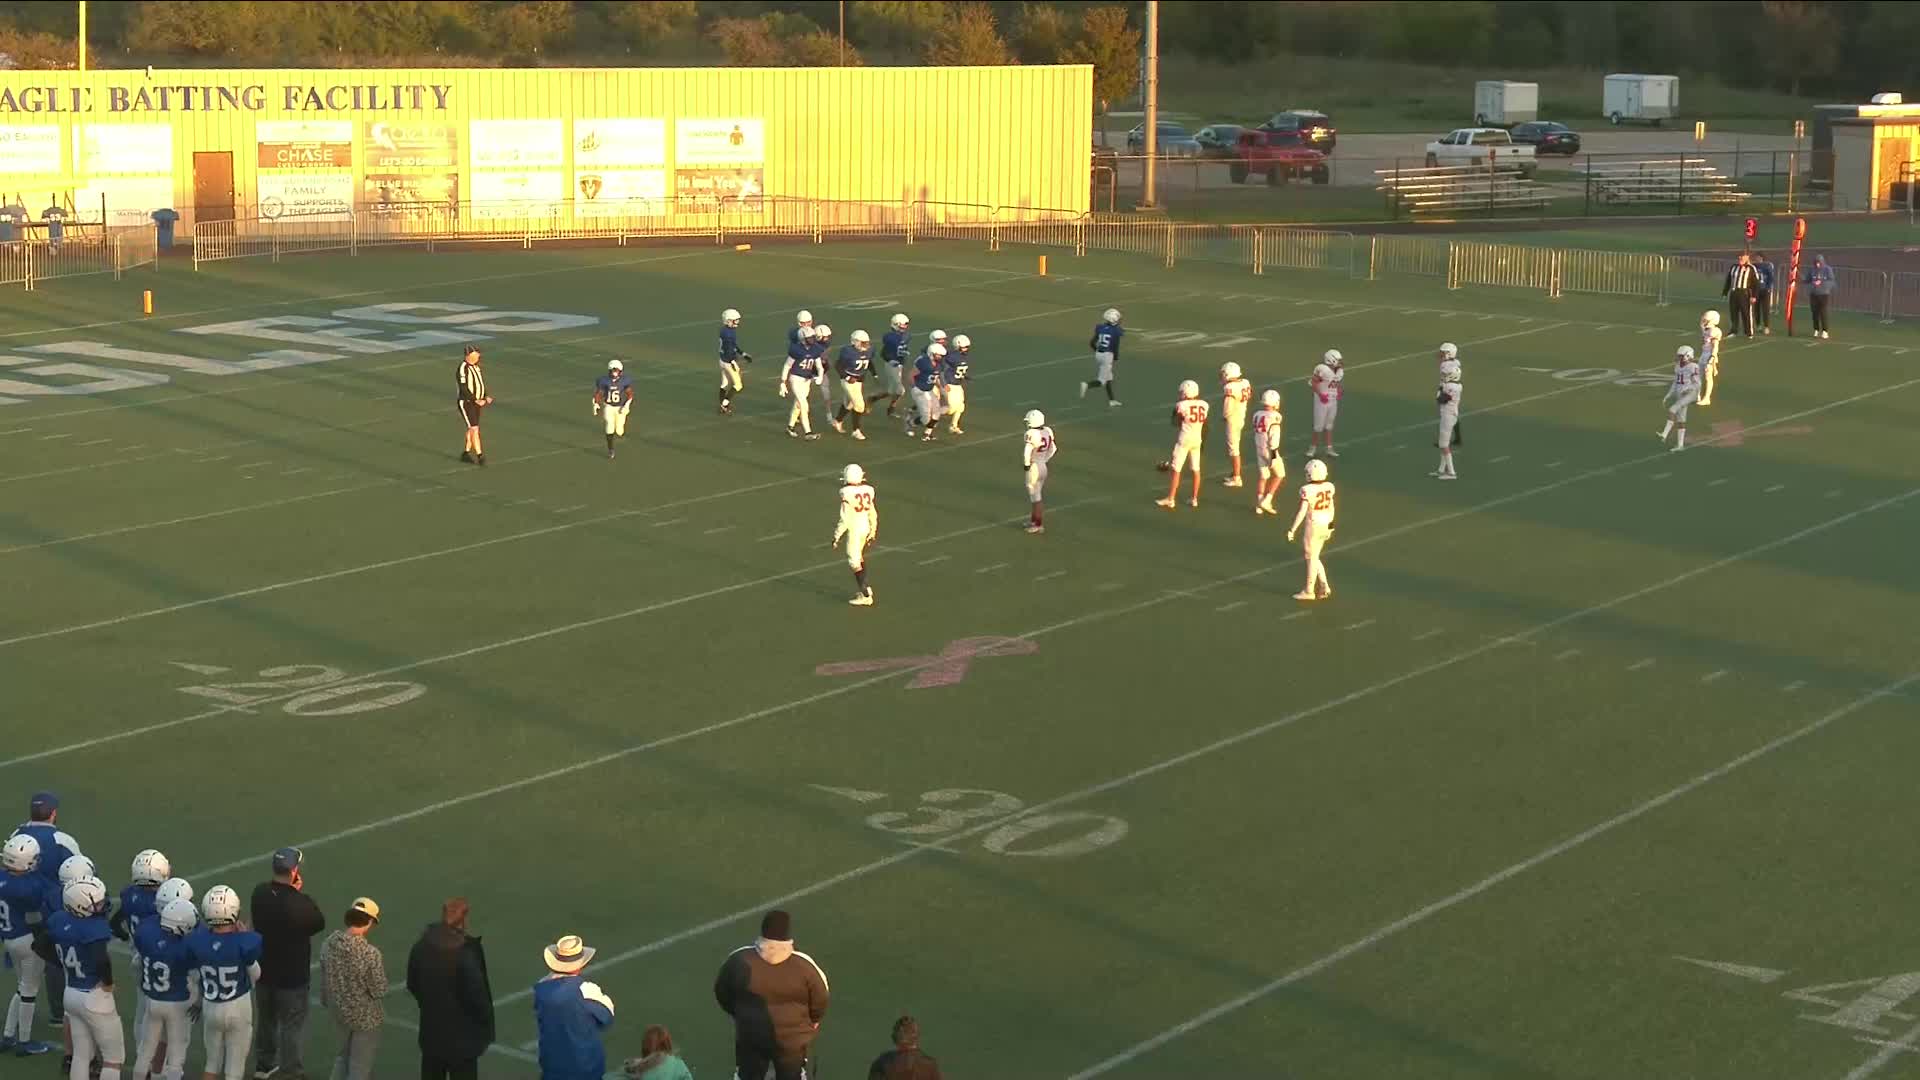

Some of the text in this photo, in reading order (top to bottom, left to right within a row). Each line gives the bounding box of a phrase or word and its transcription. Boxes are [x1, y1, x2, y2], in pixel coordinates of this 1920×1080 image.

[108, 85, 266, 111] BATTING
[282, 85, 452, 110] FACILITY
[277, 149, 333, 161] CHASE
[284, 187, 326, 195] FAMILY
[1746, 219, 1756, 236] 3
[0, 302, 600, 405] GLES
[855, 359, 870, 371] 77
[606, 390, 620, 403] 16
[1190, 405, 1206, 423] 56
[854, 493, 871, 512] 33
[1314, 490, 1331, 510] 25
[176, 664, 427, 716] 20
[866, 788, 1128, 857] 30
[142, 957, 170, 992] 13
[200, 965, 239, 1000] 65
